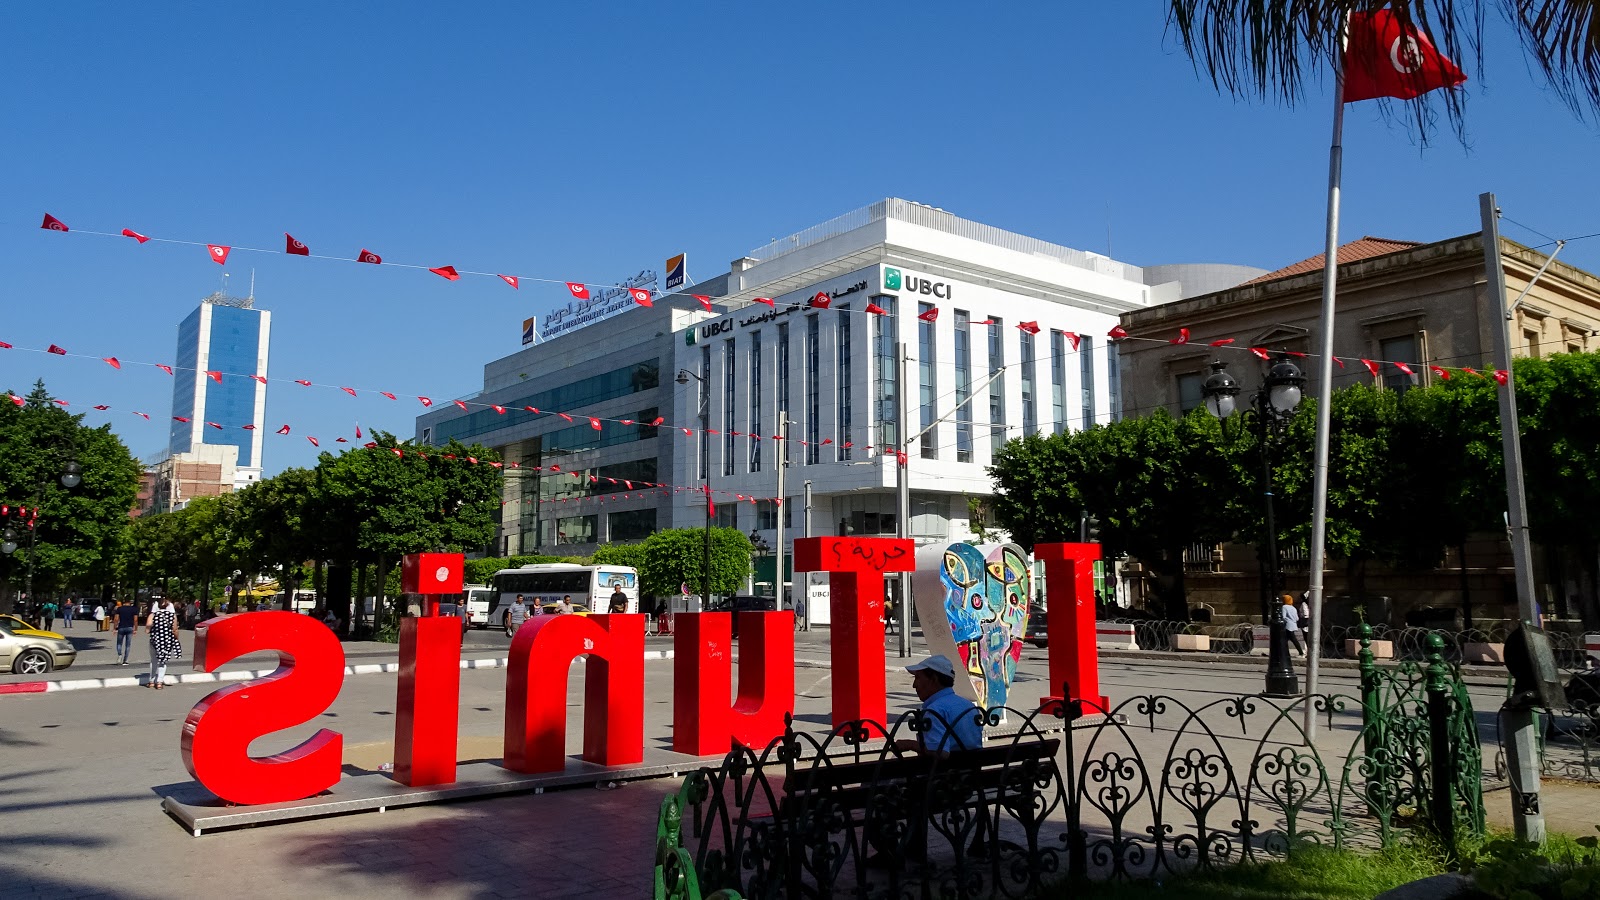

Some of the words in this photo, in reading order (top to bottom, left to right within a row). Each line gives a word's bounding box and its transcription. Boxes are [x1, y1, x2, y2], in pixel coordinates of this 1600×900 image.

[667, 275, 682, 287] BIAT
[905, 275, 951, 299] UBCI
[702, 318, 734, 339] UBCI
